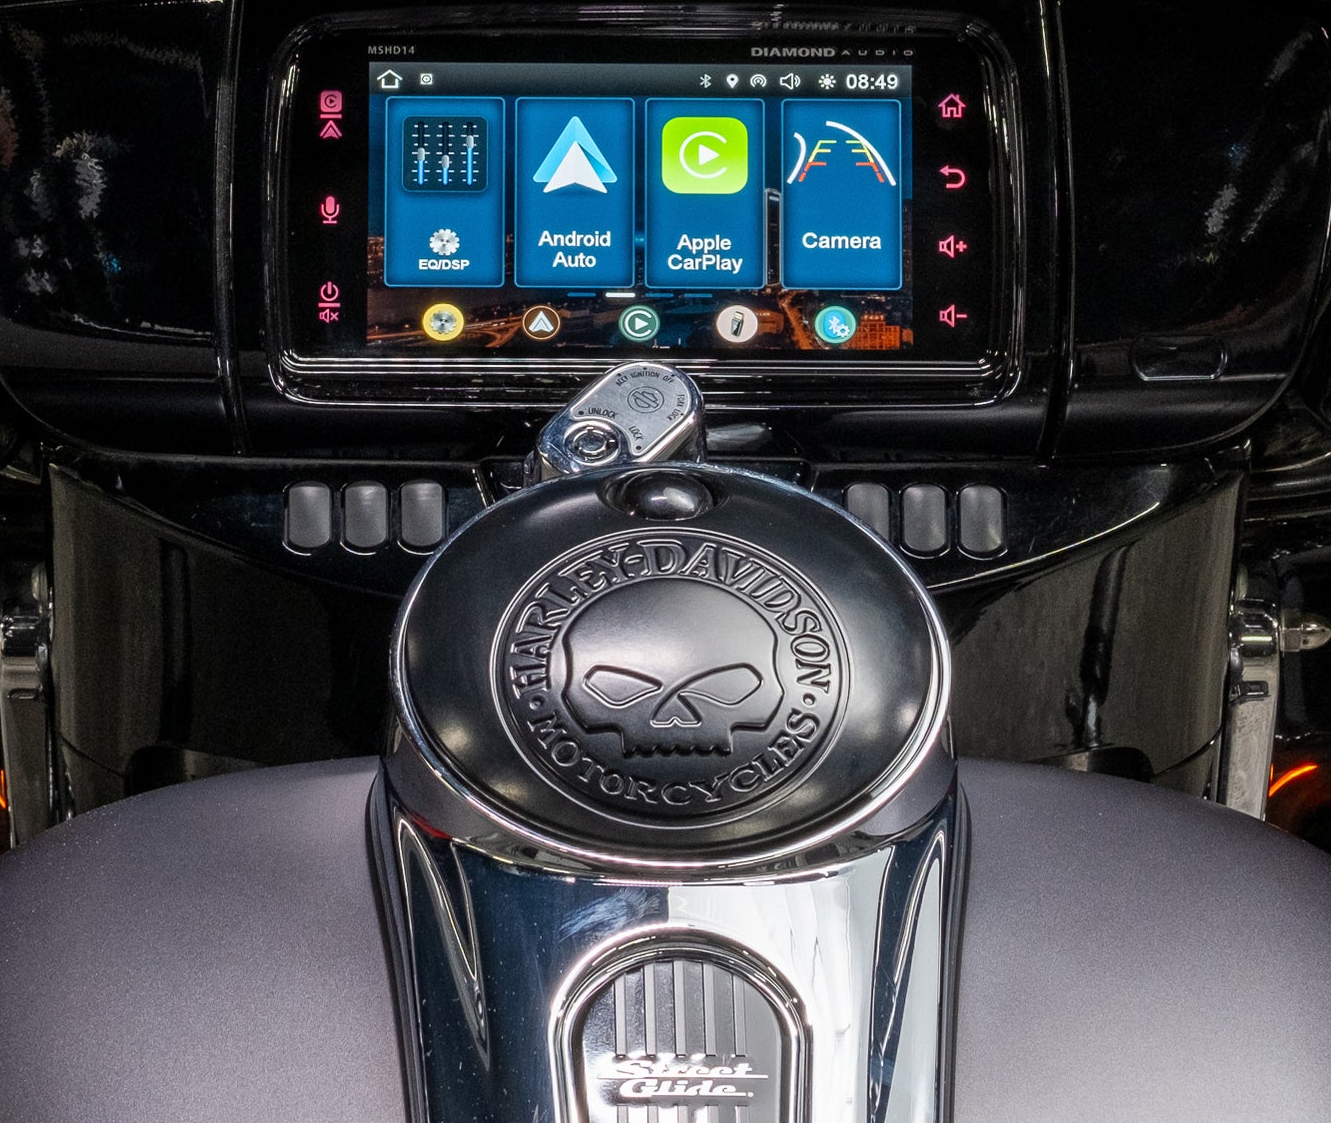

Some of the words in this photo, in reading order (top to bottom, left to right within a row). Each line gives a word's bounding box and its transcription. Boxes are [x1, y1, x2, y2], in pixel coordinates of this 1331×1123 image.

[368, 45, 415, 55] MSHD14
[751, 47, 836, 57] DIAMOND
[846, 73, 898, 90] 08:49
[538, 230, 611, 247] Android
[676, 234, 732, 255] Apple
[802, 232, 881, 249] Camera
[418, 258, 470, 271] EQ/DSP
[552, 251, 596, 268] Auto
[667, 254, 743, 275] CarPlay
[588, 408, 618, 419] UNLOCK
[629, 426, 643, 440] LOCK
[509, 539, 833, 699] HARLEY-DAVIDSON
[525, 706, 821, 807] MOTORCYCLES
